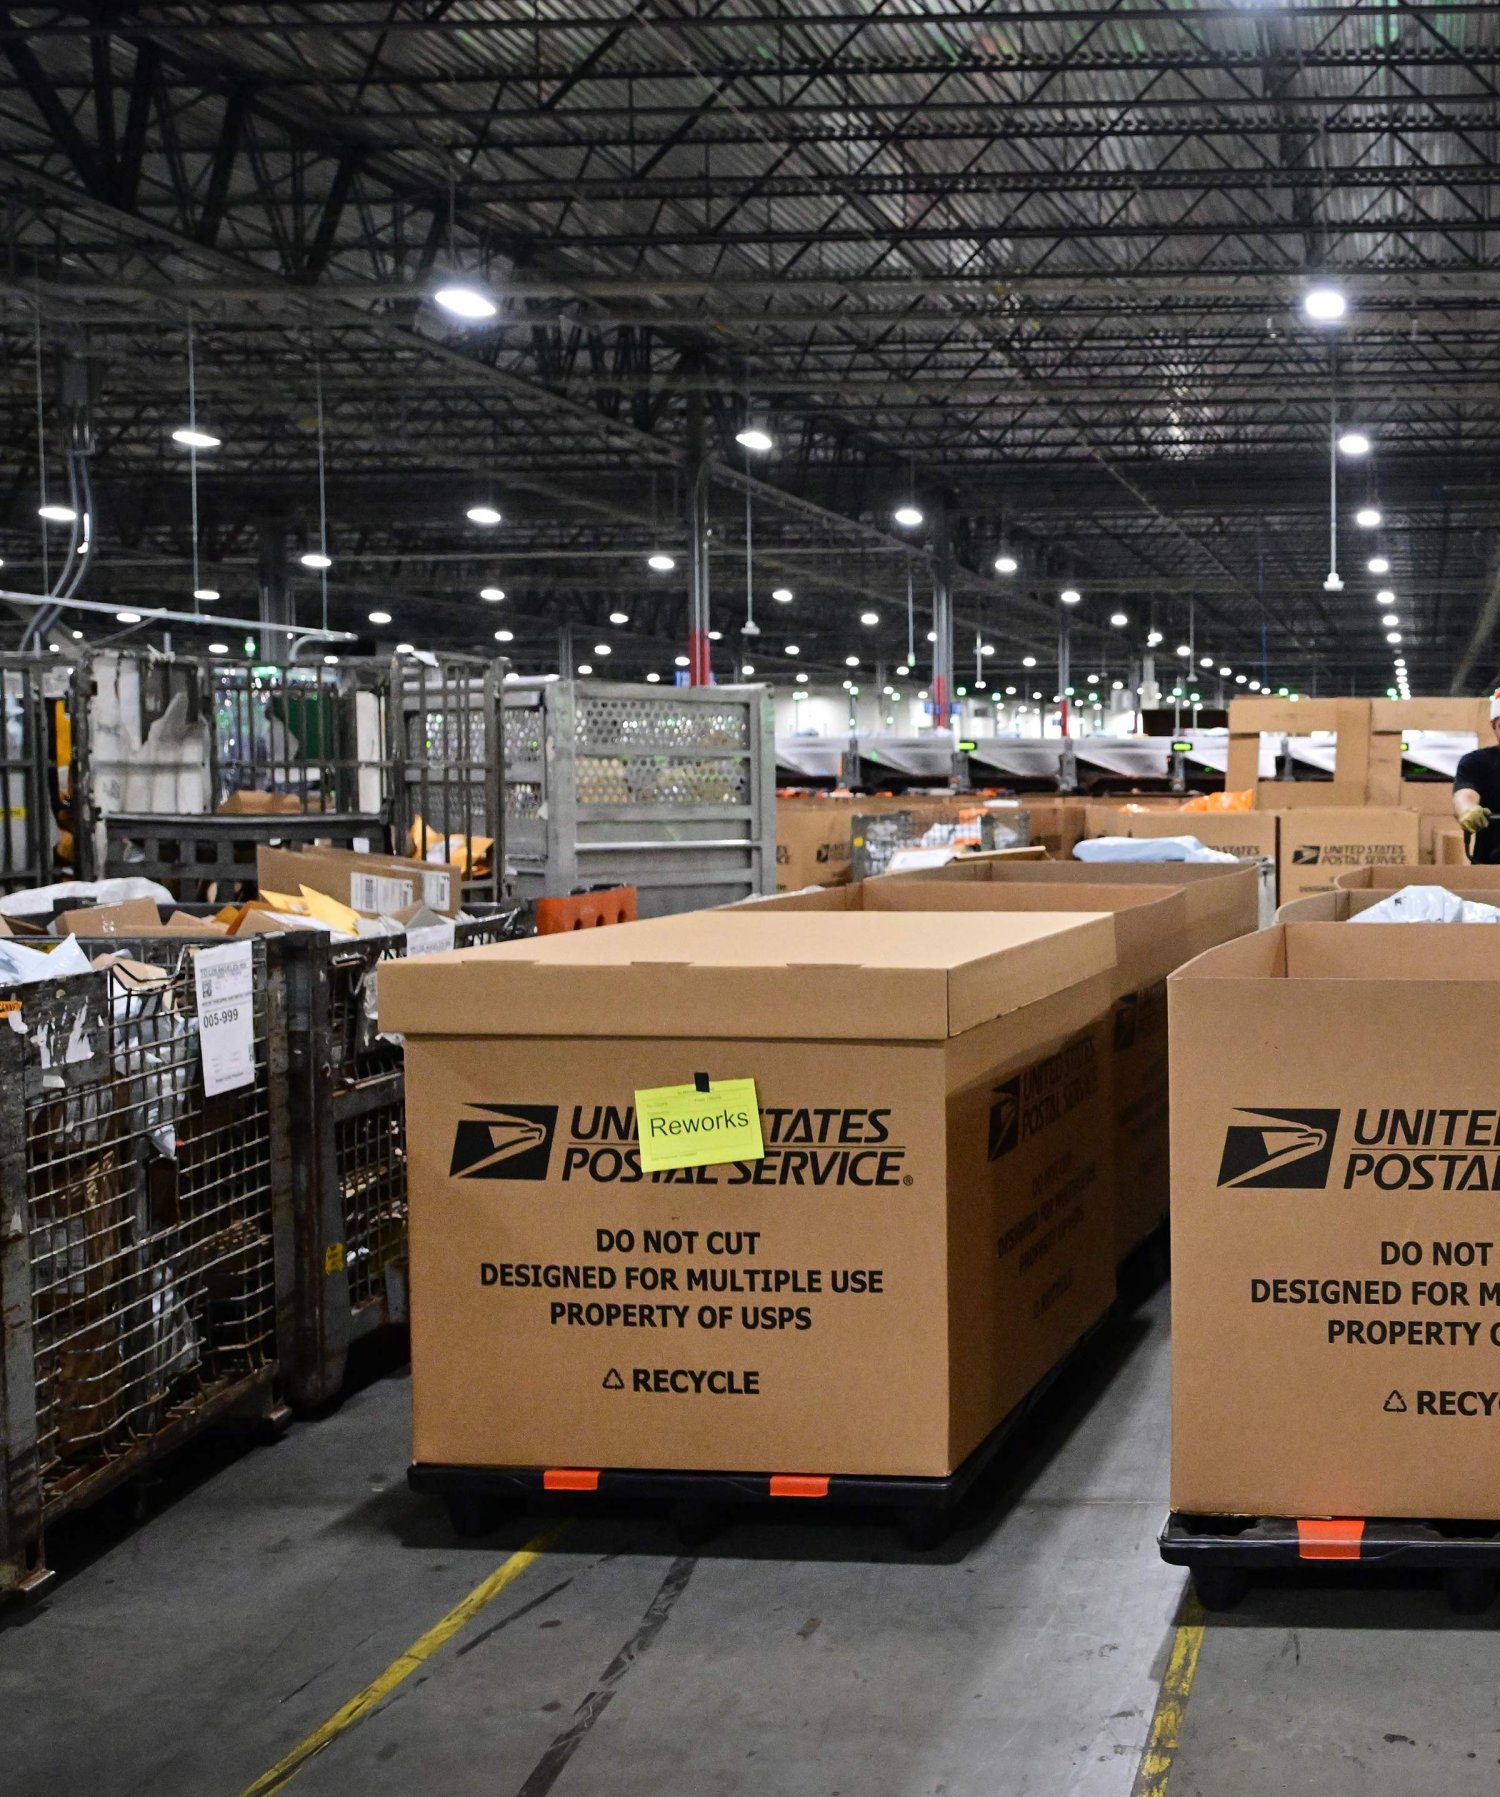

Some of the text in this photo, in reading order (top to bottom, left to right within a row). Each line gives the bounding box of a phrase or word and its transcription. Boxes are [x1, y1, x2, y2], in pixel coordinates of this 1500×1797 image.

[1322, 855, 1406, 865] POSTAL SERVICE
[1324, 845, 1404, 855] UNITED STATES
[203, 1008, 239, 1028] 005-999
[650, 1109, 749, 1137] Reworks
[763, 1109, 892, 1143] TATES
[597, 1229, 760, 1255] DO NOT CUT
[1382, 1241, 1422, 1265] DO
[1433, 1242, 1493, 1266] NOT
[481, 1263, 883, 1293] DESIGNED FOR MULTIPLE USE
[1252, 1279, 1401, 1304] DESIGNED
[1412, 1282, 1470, 1305] FOR
[551, 1302, 811, 1330] PROPERTY OF USPS
[1329, 1320, 1481, 1345] PROPERTY
[633, 1369, 759, 1394] RECYCLE
